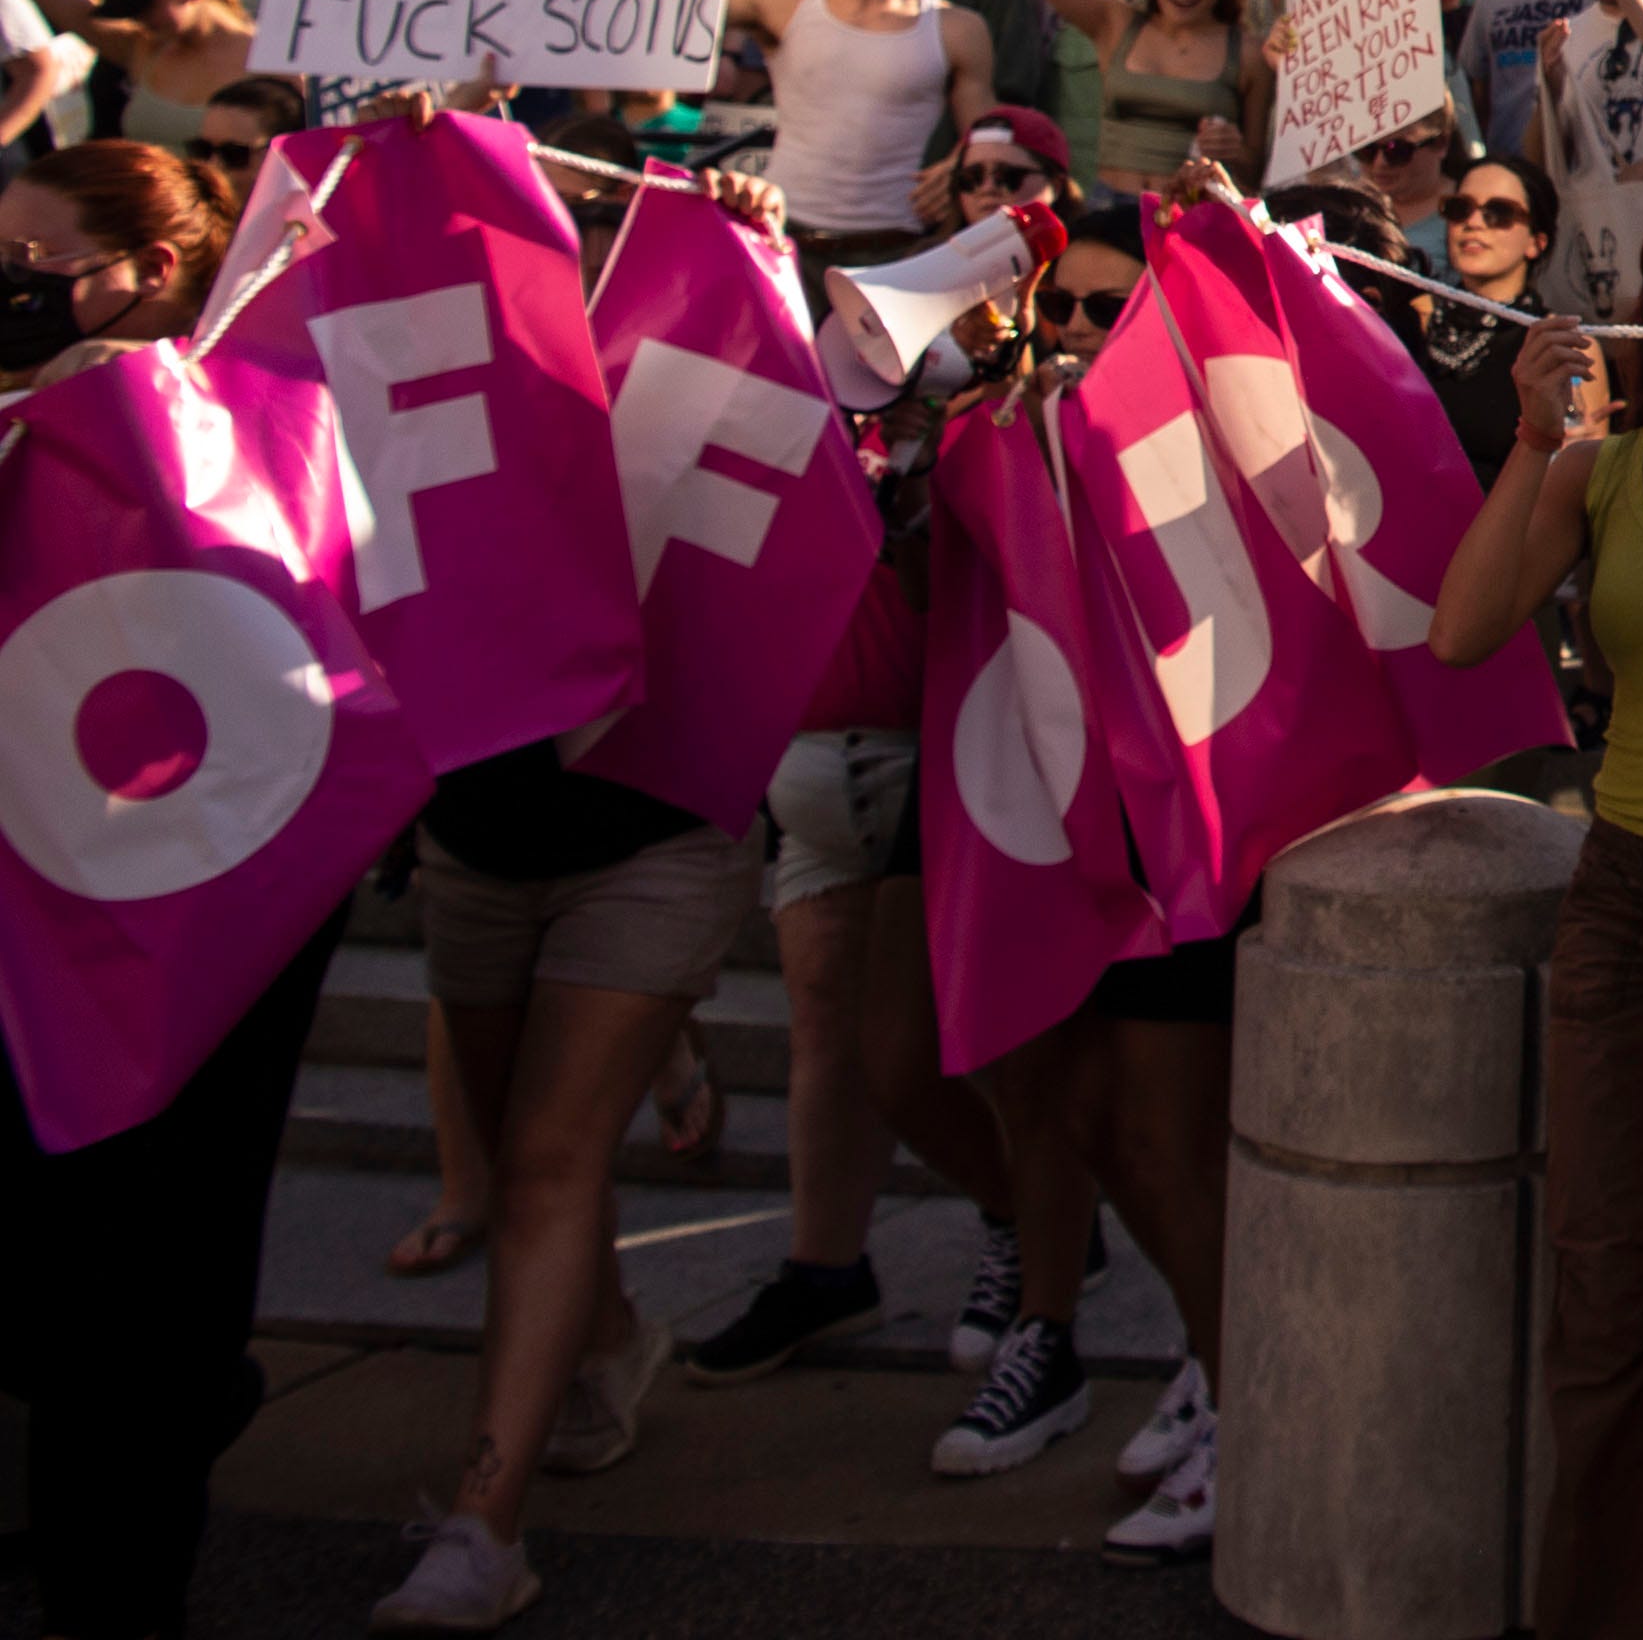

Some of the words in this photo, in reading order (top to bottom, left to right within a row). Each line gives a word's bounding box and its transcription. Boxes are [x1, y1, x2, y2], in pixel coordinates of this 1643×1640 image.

[1284, 6, 1353, 76] BEEN
[1291, 60, 1339, 101] FOR
[1353, 8, 1419, 67] YOUR
[1279, 32, 1437, 137] ABORTION
[1318, 114, 1346, 137] TO
[1369, 92, 1390, 115] BE
[1300, 98, 1413, 168] VALID
